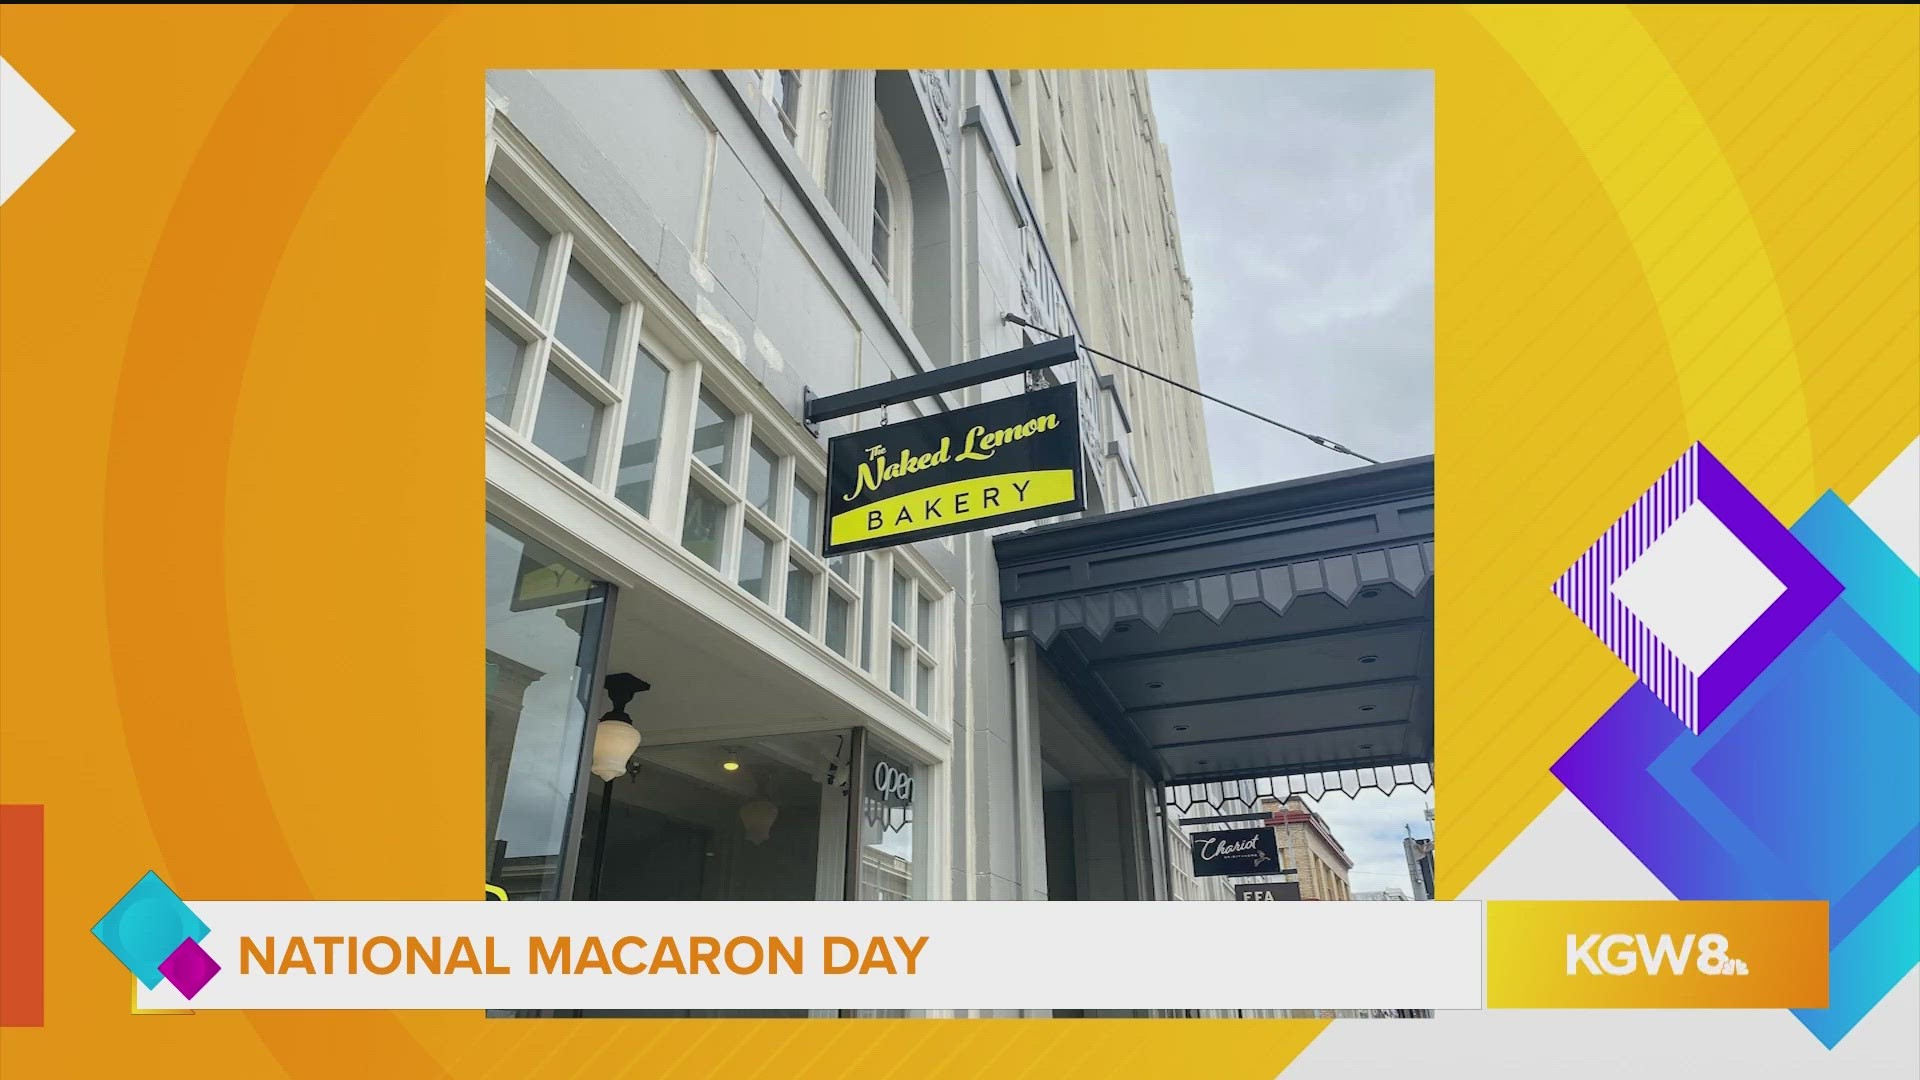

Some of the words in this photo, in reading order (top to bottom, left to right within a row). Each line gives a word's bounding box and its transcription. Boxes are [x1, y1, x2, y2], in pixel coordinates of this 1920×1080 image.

[843, 436, 952, 501] Naked
[954, 413, 1060, 462] Lemon
[865, 444, 887, 461] The
[867, 480, 1031, 531] BAKERY
[1194, 834, 1260, 860] Chariot
